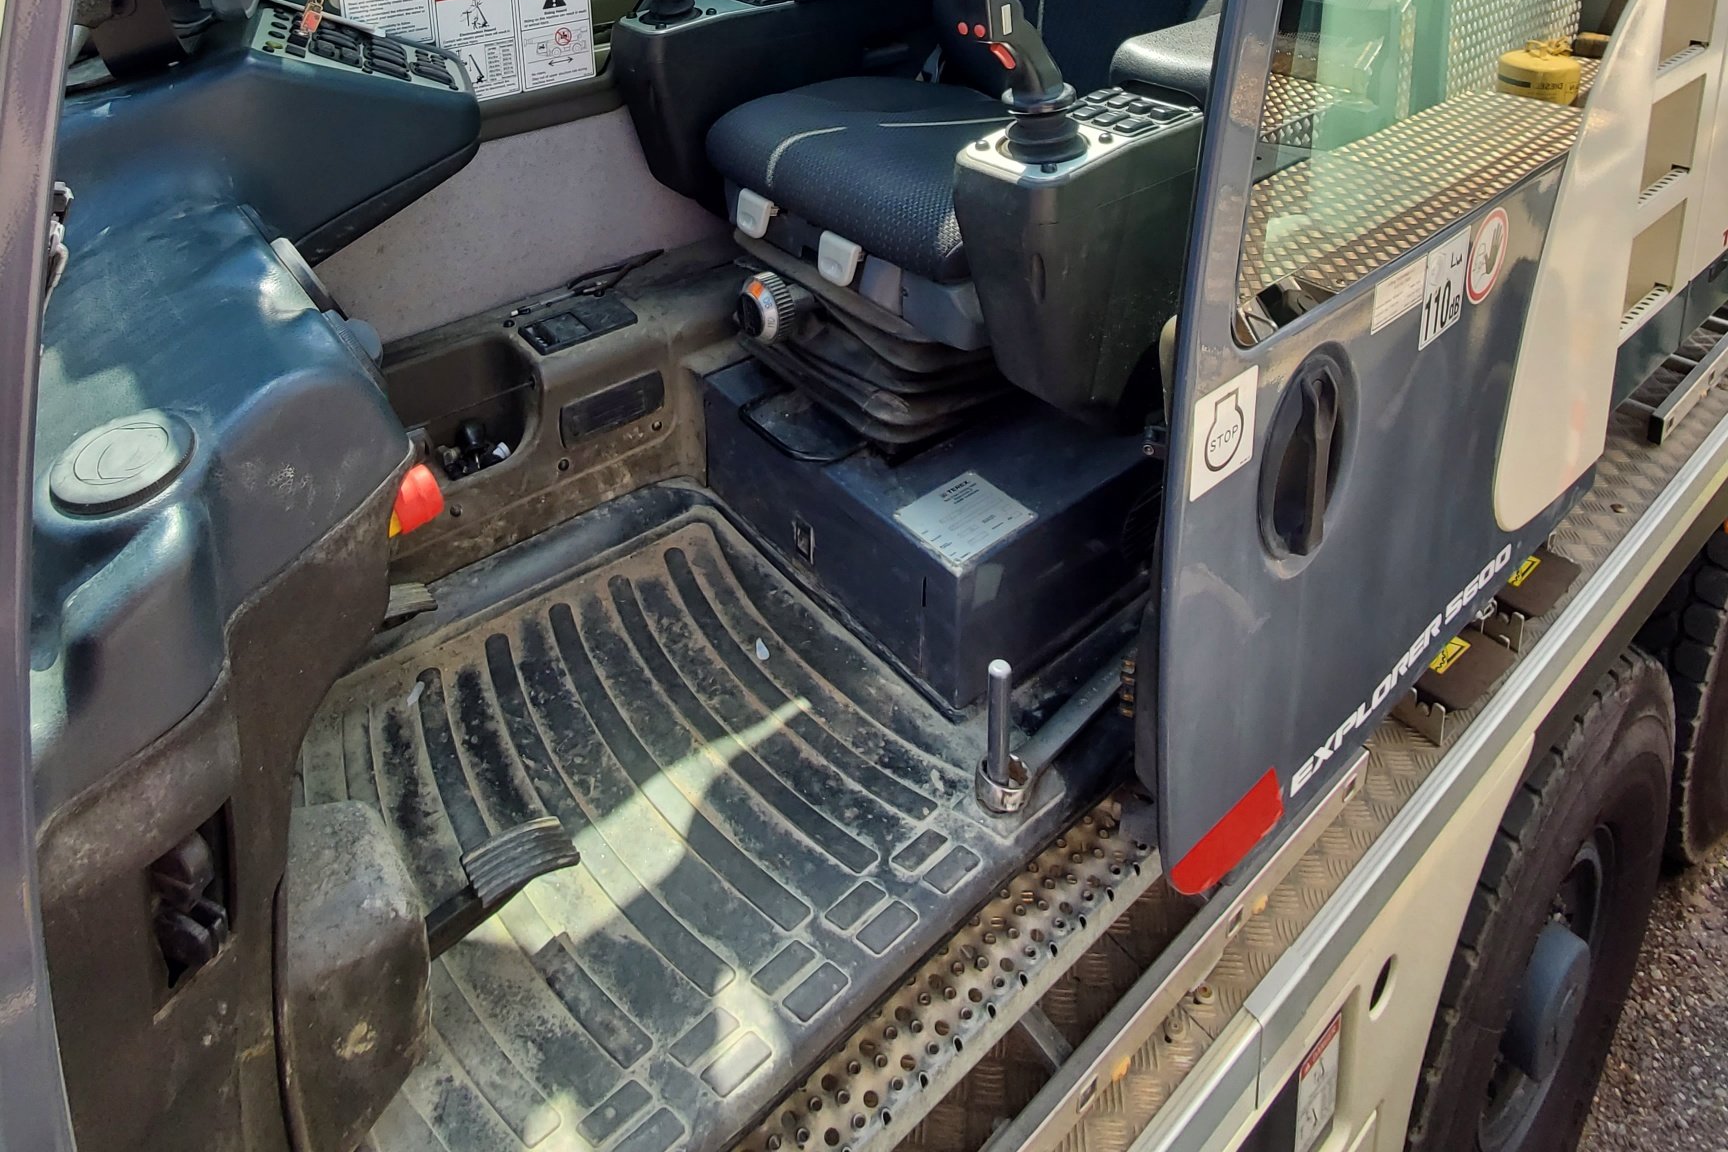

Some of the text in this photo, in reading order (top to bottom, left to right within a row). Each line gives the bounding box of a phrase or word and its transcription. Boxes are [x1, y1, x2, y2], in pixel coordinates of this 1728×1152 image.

[1209, 424, 1239, 453] STOP
[1290, 544, 1512, 798] EXPLORER 5600
